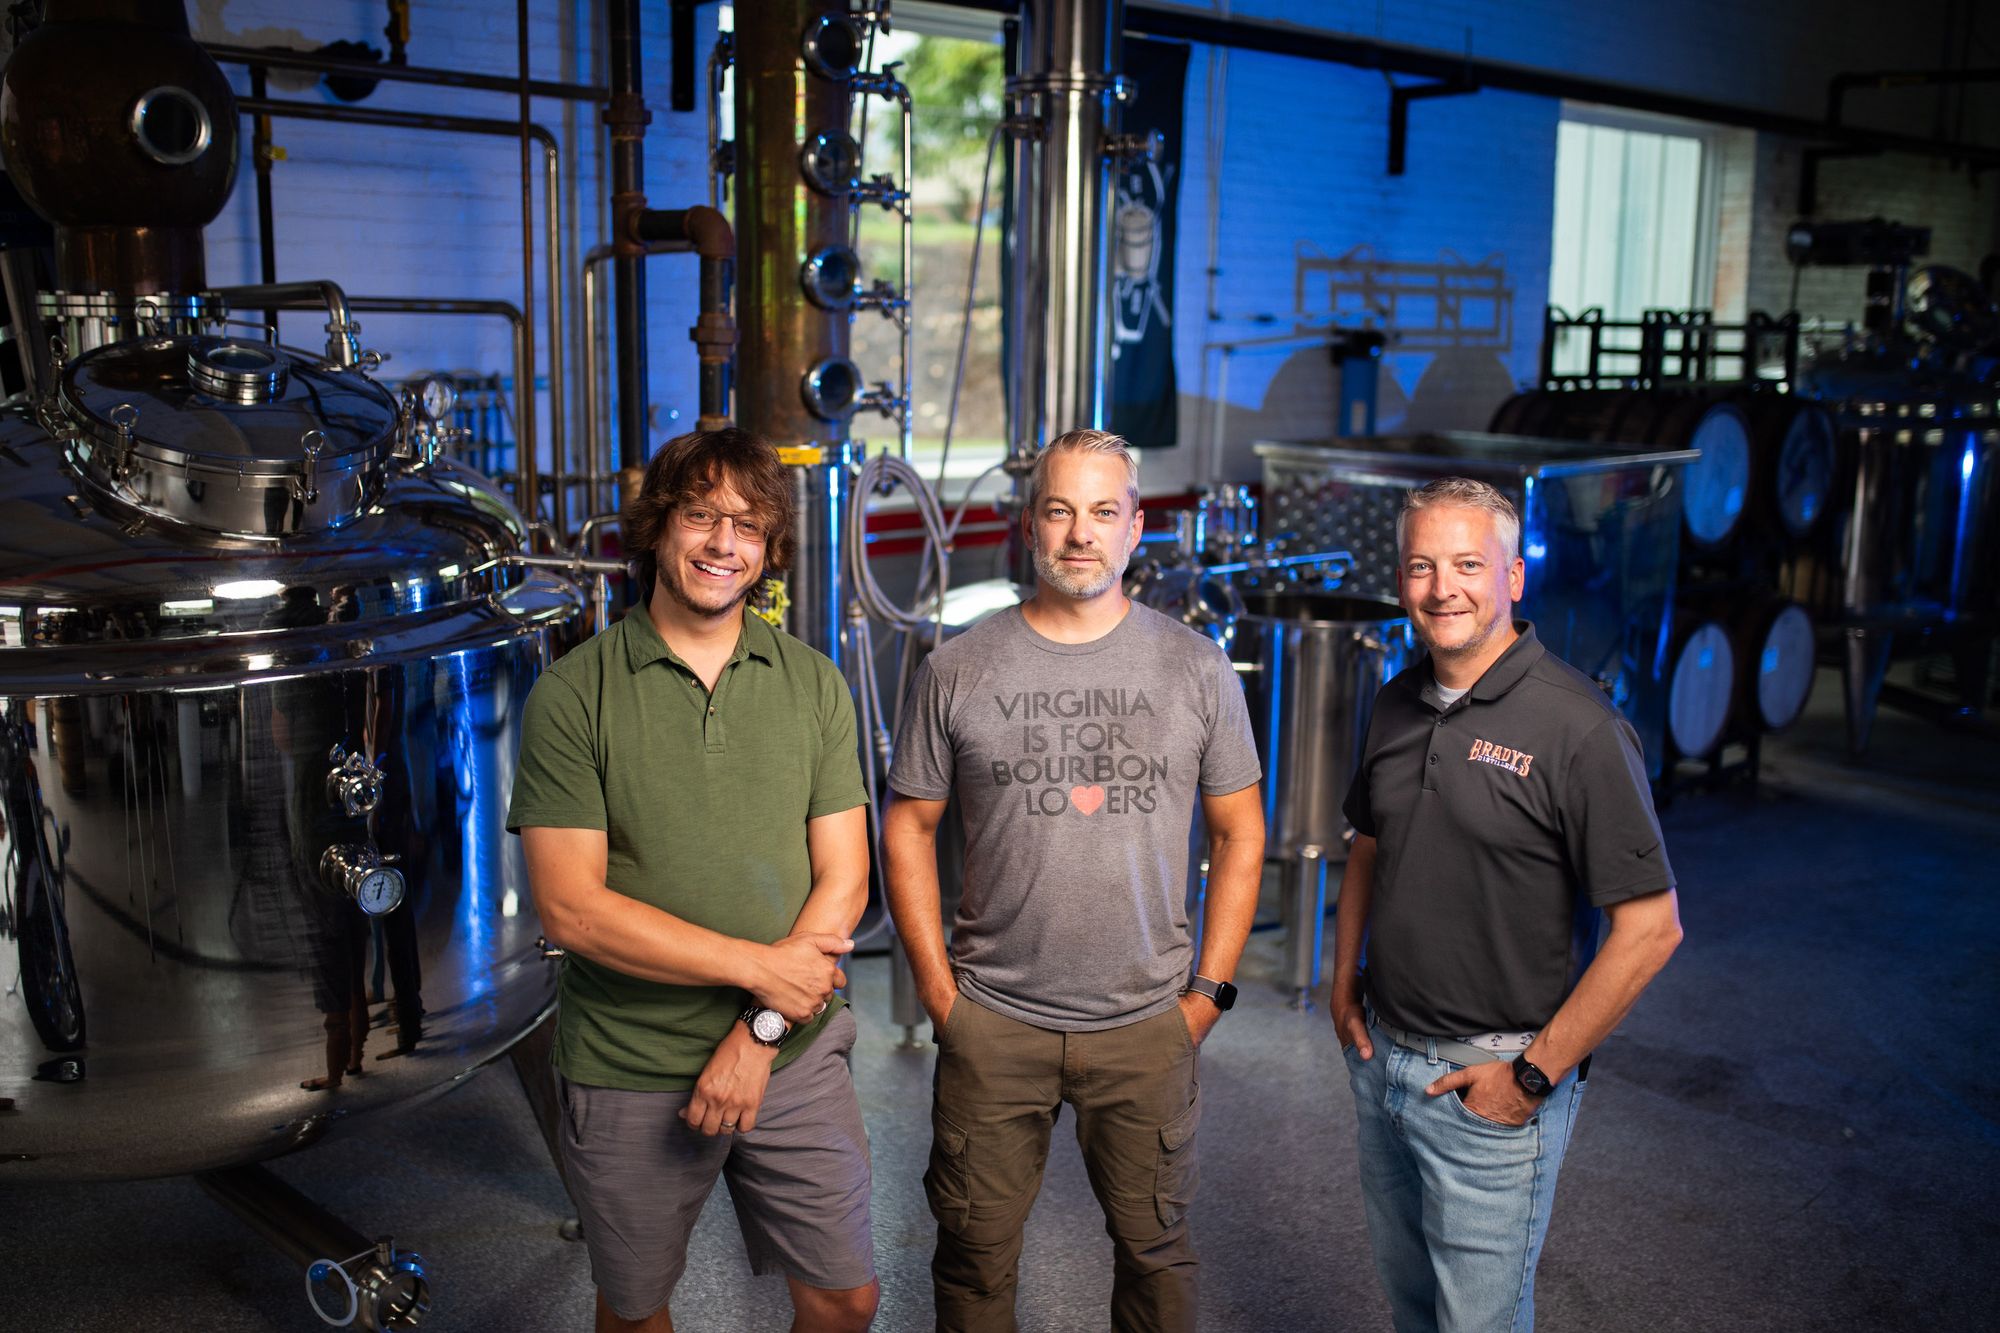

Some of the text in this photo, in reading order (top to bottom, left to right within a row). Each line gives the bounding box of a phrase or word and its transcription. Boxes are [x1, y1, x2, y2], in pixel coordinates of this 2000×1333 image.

[994, 688, 1155, 721] VIRGINIA
[1023, 722, 1135, 753] IS FOR
[991, 754, 1168, 786] BOURBON
[1468, 738, 1534, 778] BRADY'S
